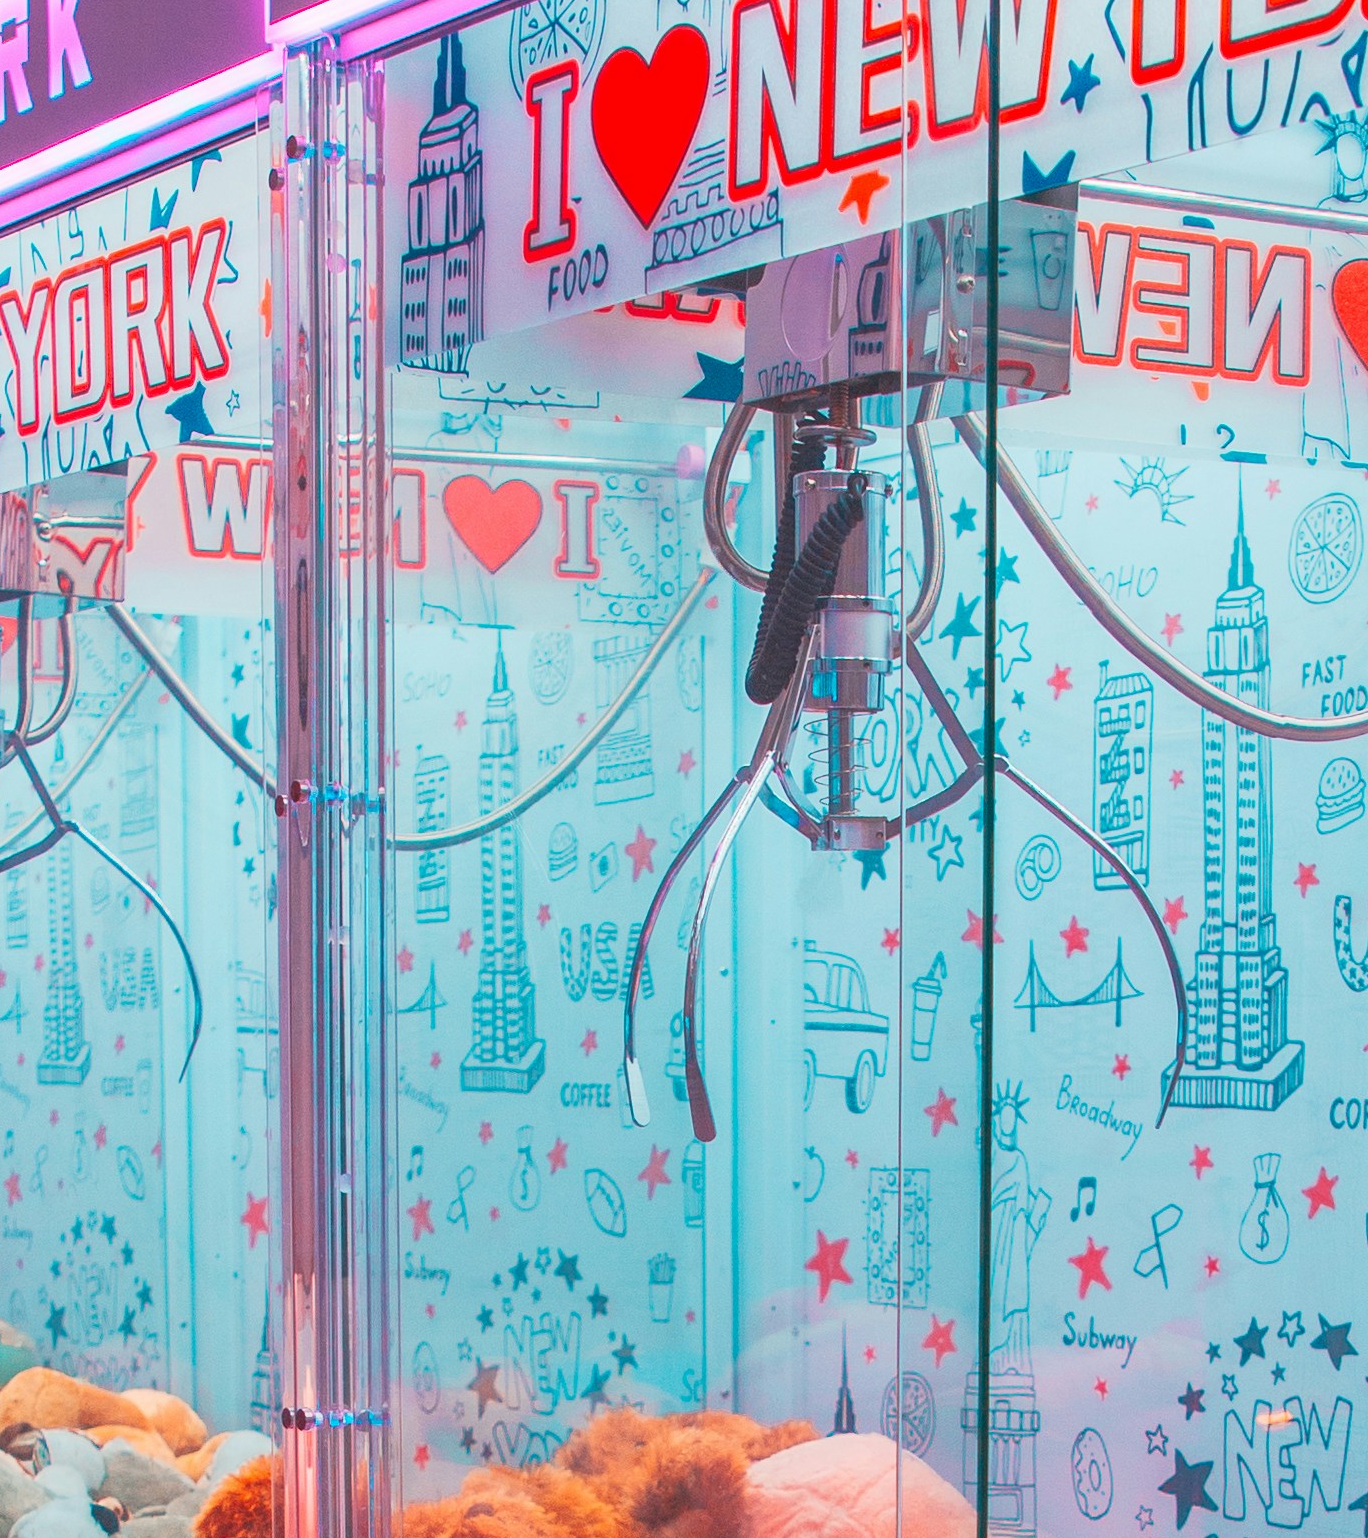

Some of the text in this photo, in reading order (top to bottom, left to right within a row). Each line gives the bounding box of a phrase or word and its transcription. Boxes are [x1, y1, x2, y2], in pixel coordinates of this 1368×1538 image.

[522, 67, 578, 265] I
[547, 244, 609, 312] FOOD
[1302, 655, 1347, 687] FAST
[1322, 685, 1368, 717] FOOD
[559, 921, 655, 1002] USA
[560, 1082, 612, 1109] COFFEE
[503, 1311, 582, 1416] NEW
[1063, 1312, 1137, 1369] Subway
[1223, 1395, 1353, 1529] NEW
